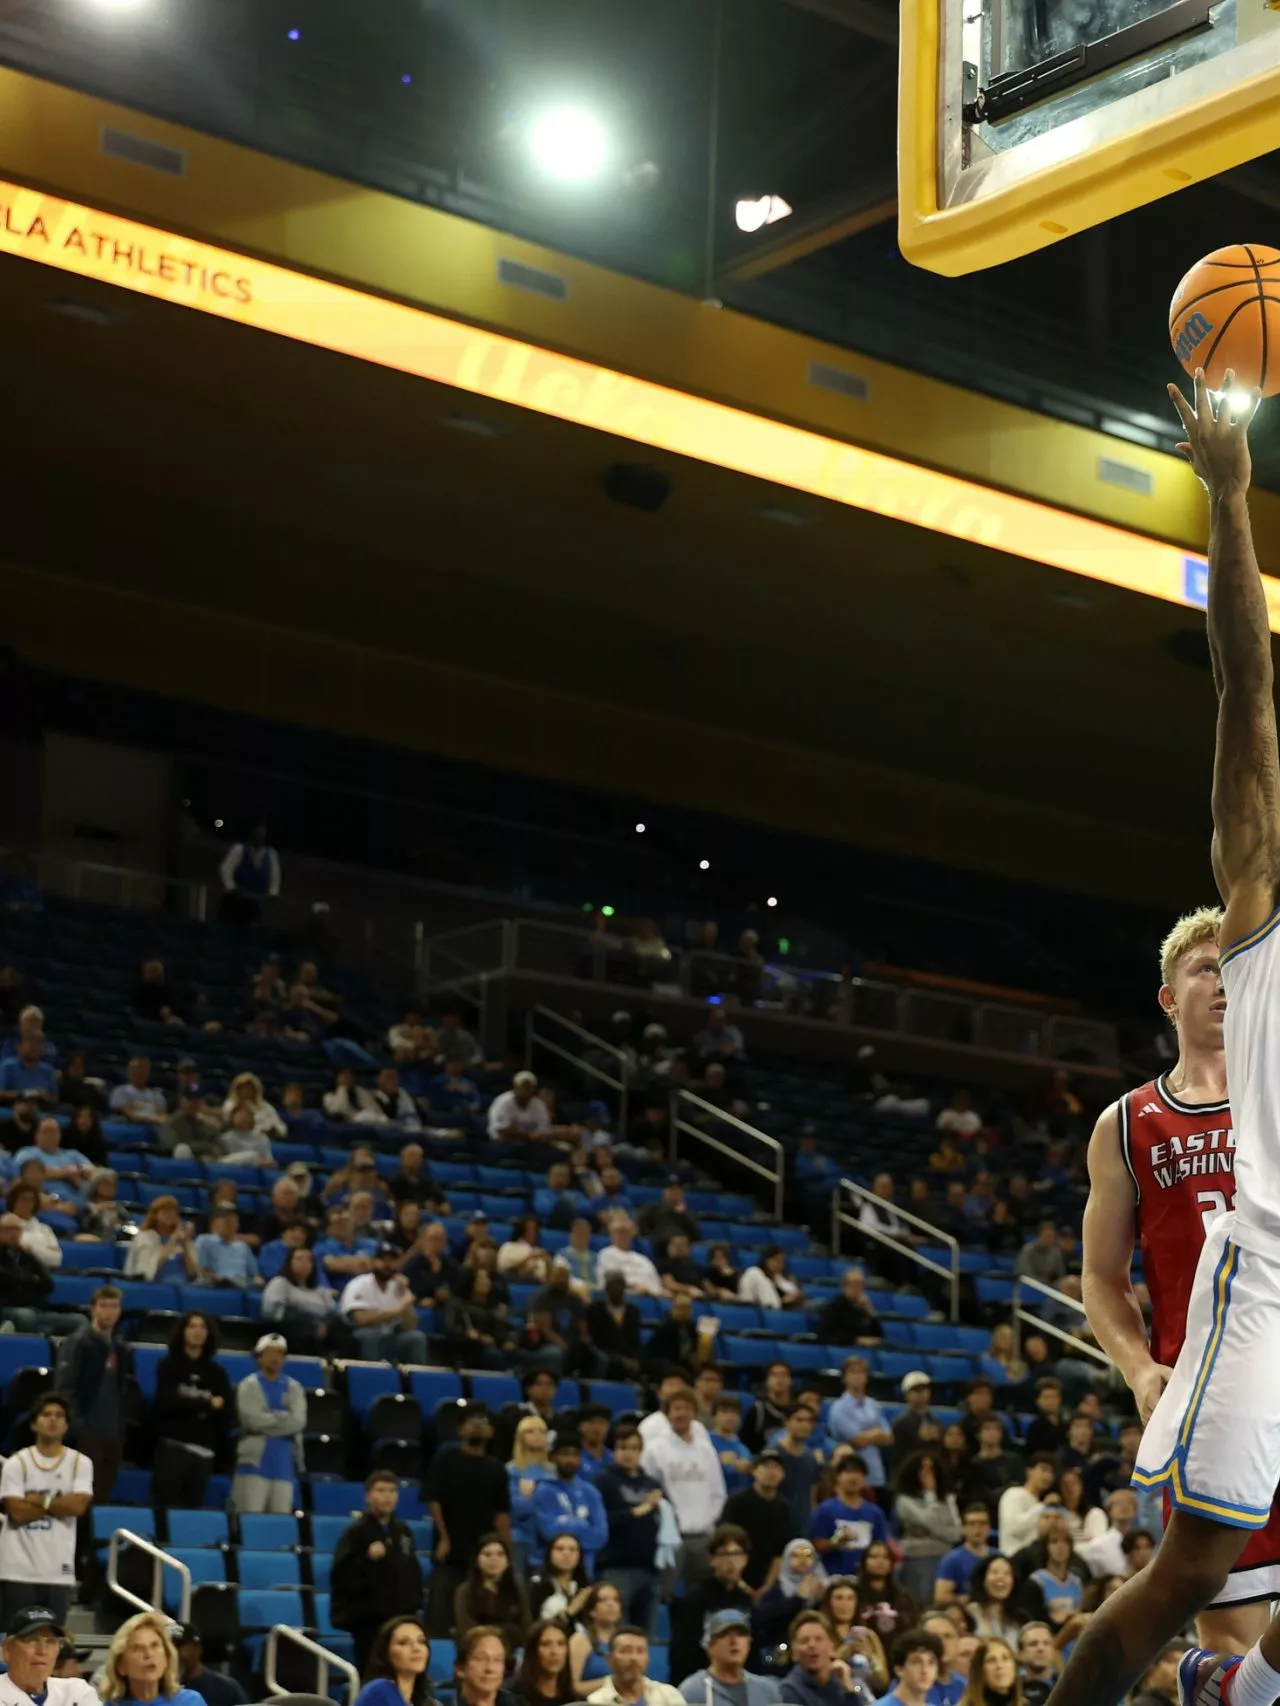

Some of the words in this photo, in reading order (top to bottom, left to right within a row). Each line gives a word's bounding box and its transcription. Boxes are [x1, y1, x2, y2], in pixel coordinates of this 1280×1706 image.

[0, 205, 51, 244] LA
[63, 225, 253, 305] ATHLETICS
[1153, 1152, 1236, 1190] WASHIN
[1196, 1189, 1237, 1238] 2
